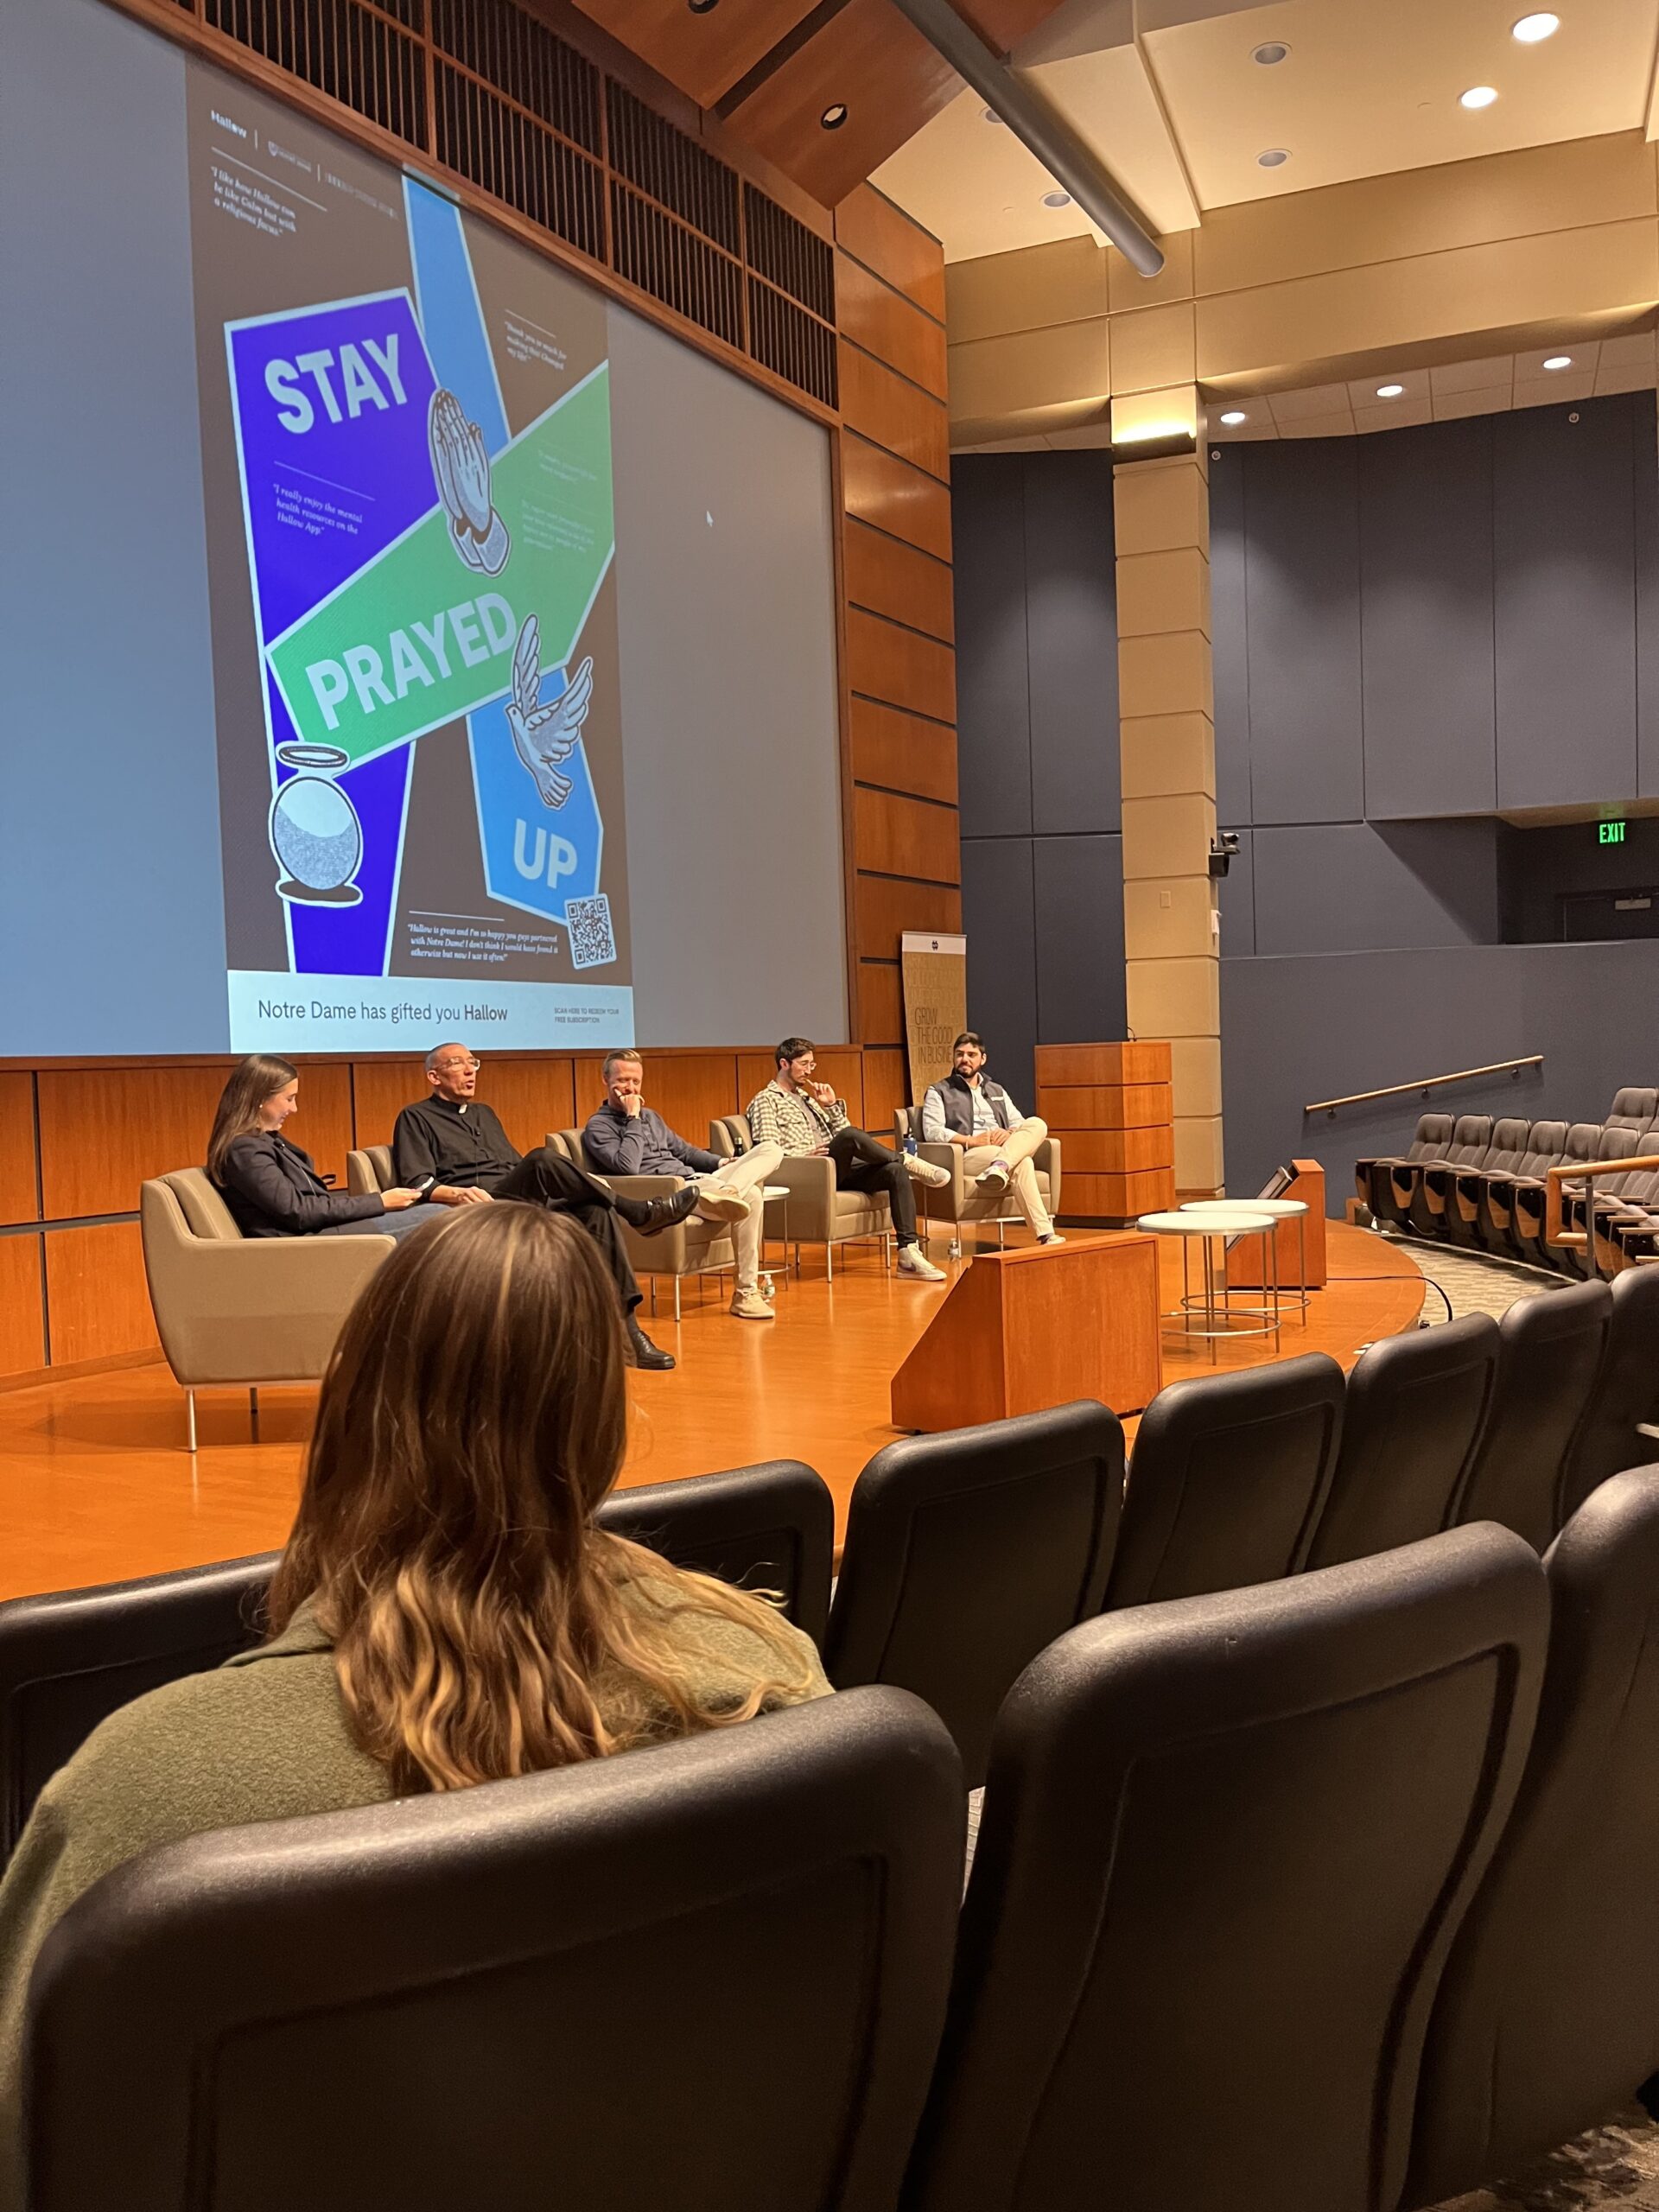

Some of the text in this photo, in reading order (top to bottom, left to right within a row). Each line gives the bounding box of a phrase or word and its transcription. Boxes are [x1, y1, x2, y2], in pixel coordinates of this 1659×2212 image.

[219, 170, 234, 186] like
[225, 187, 240, 203] like
[264, 333, 407, 434] STAY
[281, 487, 302, 503] really
[303, 497, 323, 512] enjoy
[324, 502, 336, 514] the
[337, 508, 363, 523] mental
[276, 498, 358, 534] health resources on the
[277, 511, 304, 529] Hallow
[305, 593, 517, 730] PRAYED
[1599, 822, 1625, 843] EXIT
[514, 818, 577, 889] UP
[407, 924, 432, 933] "Hallow
[439, 926, 456, 937] great
[456, 927, 468, 936] and
[486, 929, 505, 940] happy
[505, 932, 517, 941] you
[517, 933, 530, 943] guys
[530, 934, 557, 943] partnered
[410, 937, 425, 945] with
[426, 937, 444, 946] Notre
[469, 940, 483, 949] don't
[485, 941, 500, 950] think
[505, 943, 522, 951] would
[536, 944, 553, 954] found
[410, 947, 442, 957] otherwise
[442, 949, 453, 958] but
[483, 952, 487, 961] it
[258, 1000, 507, 1025] Notre Dame has gifted you Hallow
[915, 1007, 938, 1026] GROW
[918, 1026, 953, 1045] THE GOOD
[918, 1046, 953, 1065] IN BUSINE
